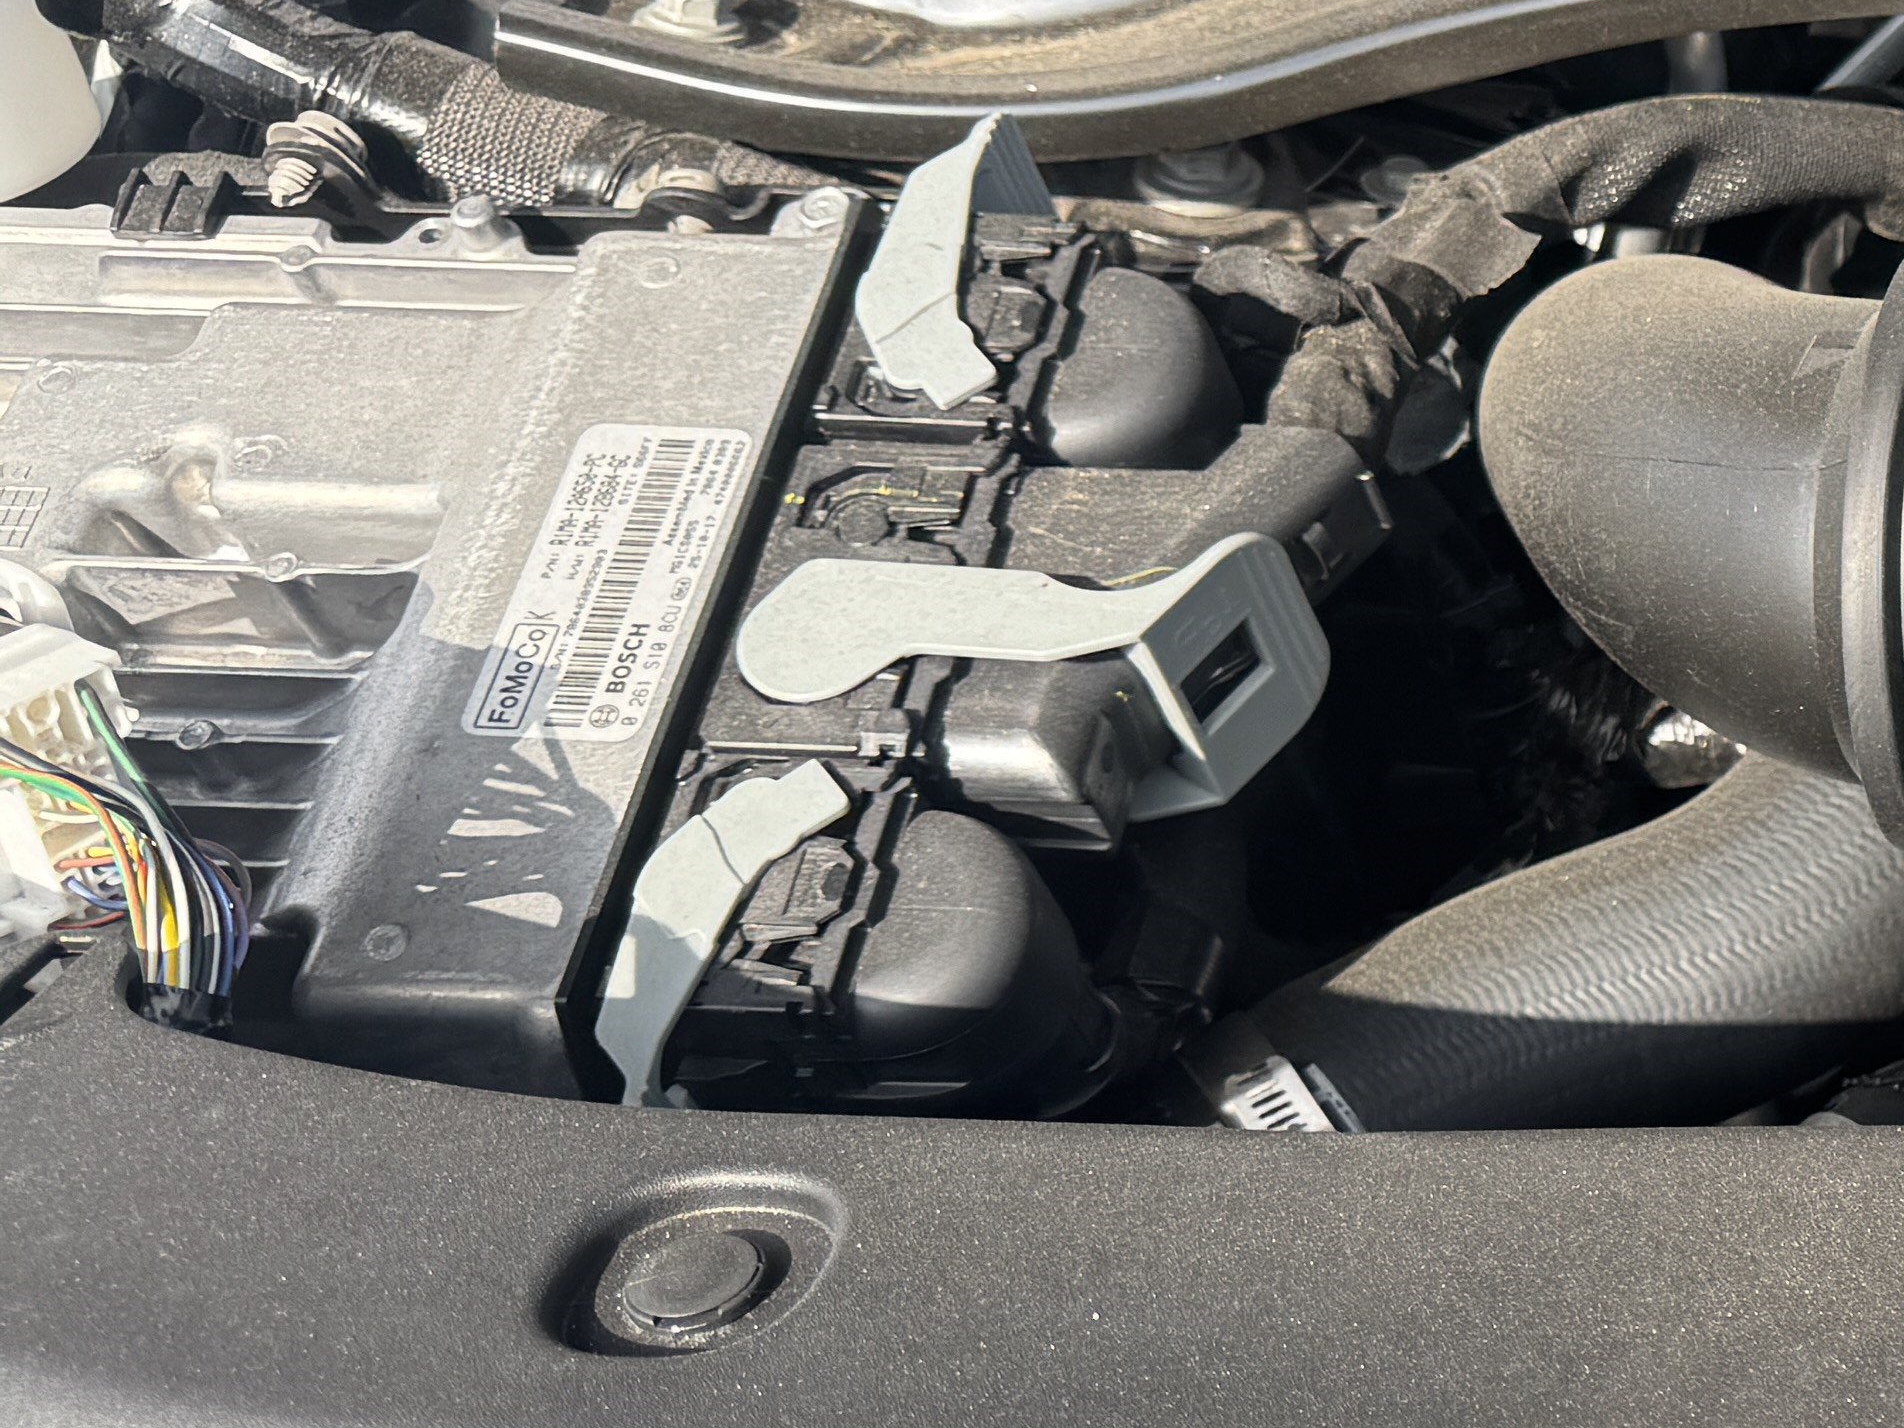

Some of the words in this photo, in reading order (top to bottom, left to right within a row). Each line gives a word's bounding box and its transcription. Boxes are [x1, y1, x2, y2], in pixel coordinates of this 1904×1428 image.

[487, 627, 547, 723] FoMoCo
[604, 622, 650, 693] BOSCH
[628, 680, 651, 706] 261
